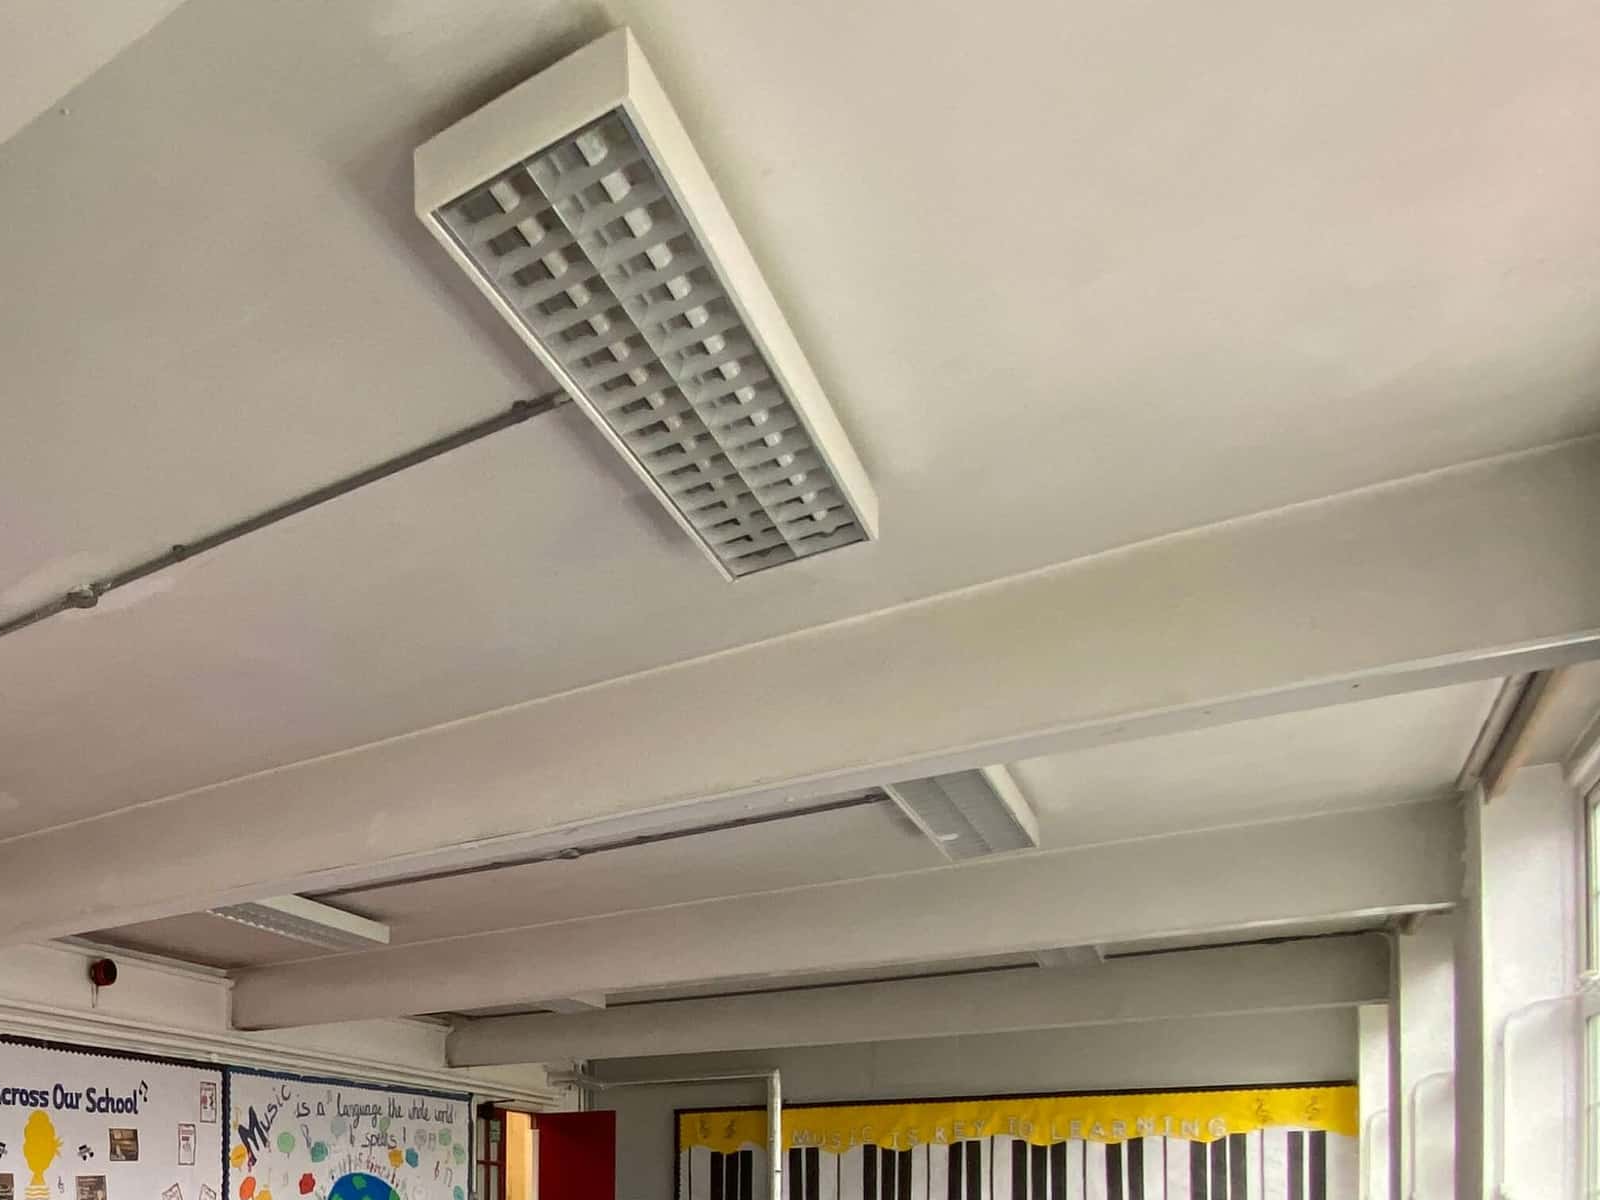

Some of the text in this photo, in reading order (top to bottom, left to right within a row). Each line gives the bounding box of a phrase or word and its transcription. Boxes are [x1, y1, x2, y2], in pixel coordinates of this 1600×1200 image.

[52, 1083, 83, 1110] Our
[85, 1086, 139, 1114] School
[238, 1085, 292, 1167] Music
[337, 1092, 383, 1129] language
[792, 1115, 1227, 1148] MUSIC IS KEY TO LEARNING
